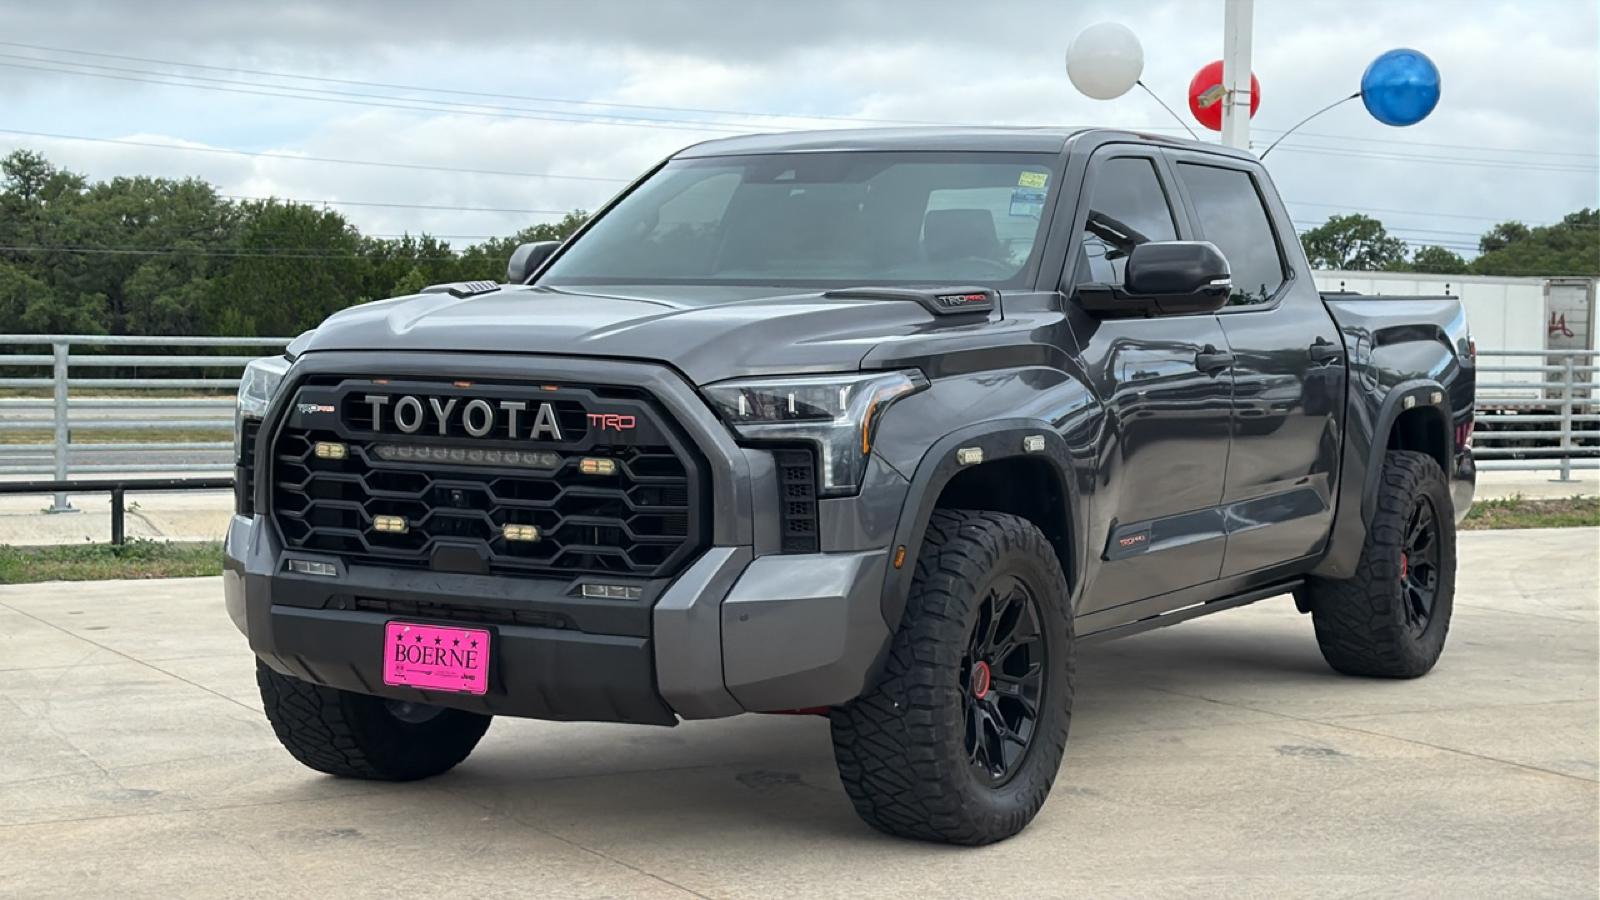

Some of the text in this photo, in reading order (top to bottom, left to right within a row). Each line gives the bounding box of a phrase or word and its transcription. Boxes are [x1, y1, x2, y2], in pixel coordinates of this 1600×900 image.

[365, 395, 562, 440] TOYOTA
[586, 413, 636, 431] TRD
[394, 643, 478, 670] BOERNE
